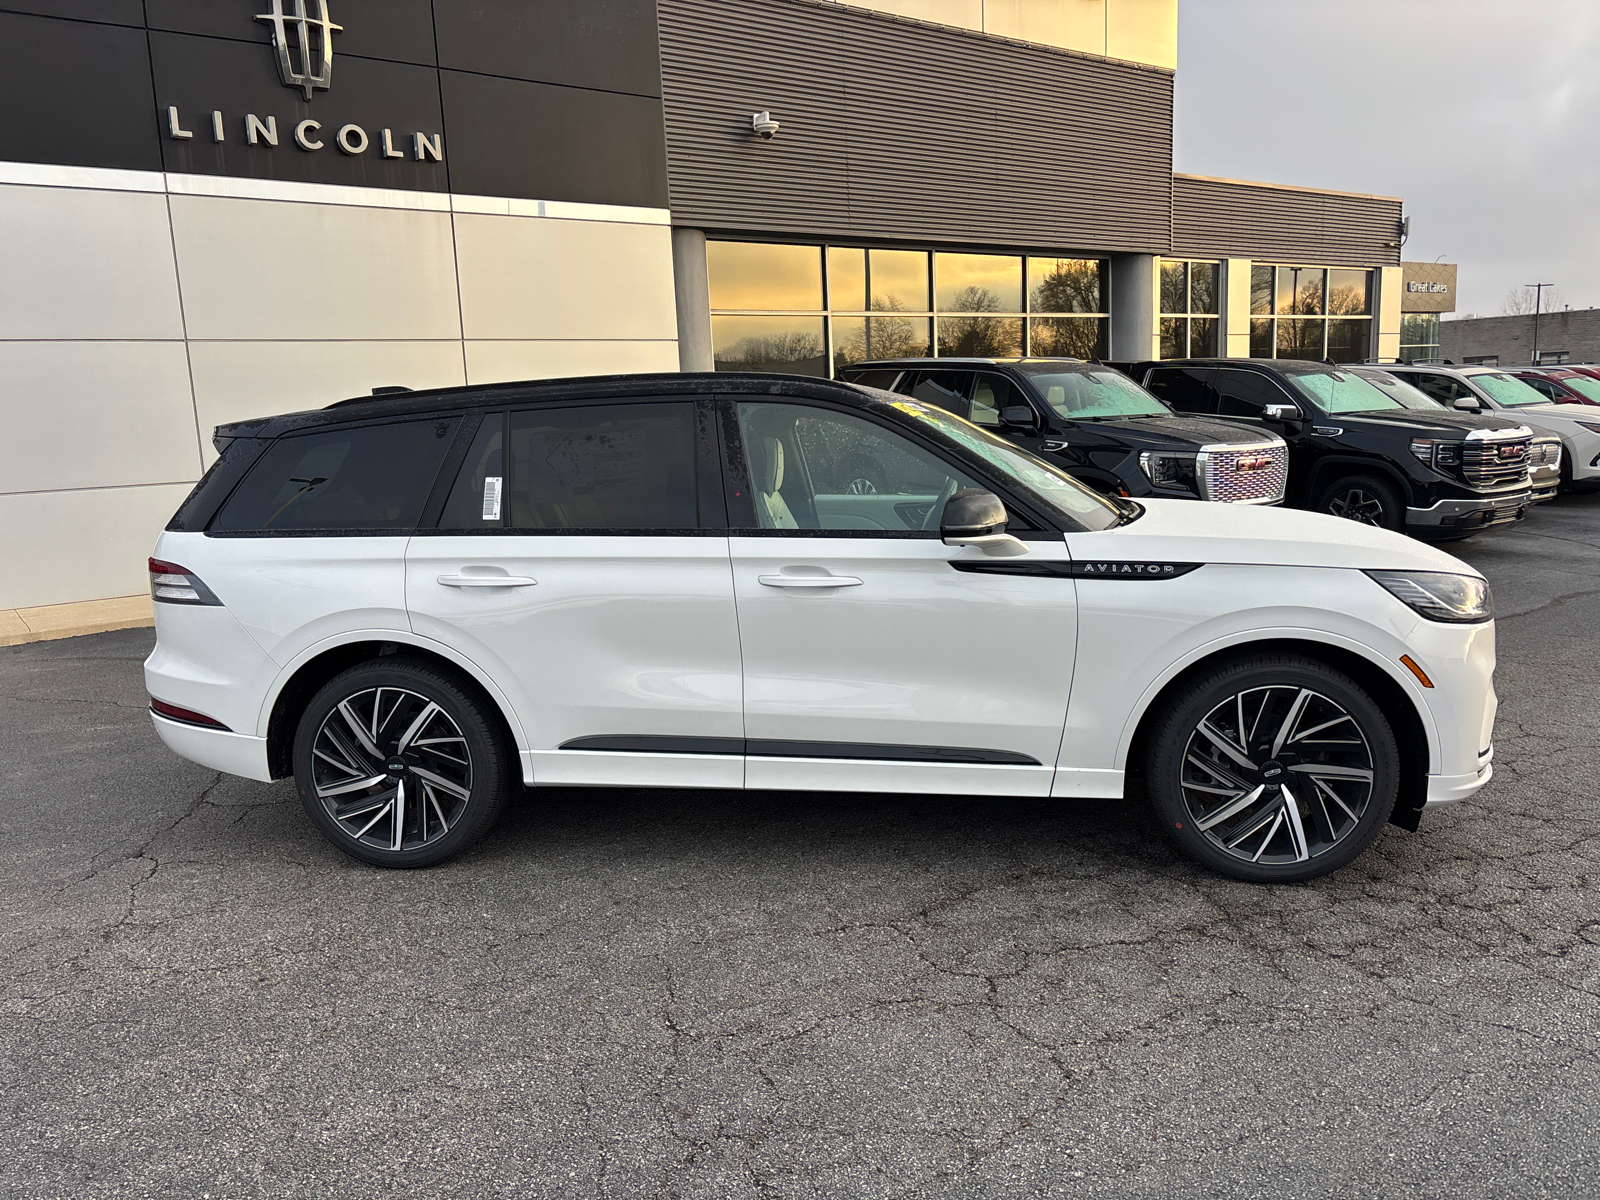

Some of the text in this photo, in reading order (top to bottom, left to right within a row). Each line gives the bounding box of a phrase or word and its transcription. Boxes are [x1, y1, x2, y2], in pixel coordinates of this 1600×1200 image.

[168, 105, 443, 162] LINCOLN
[1409, 281, 1448, 293] Great Lakes
[1501, 445, 1525, 457] GMC
[1238, 457, 1272, 471] GMC
[1083, 563, 1174, 574] AVIATOR
